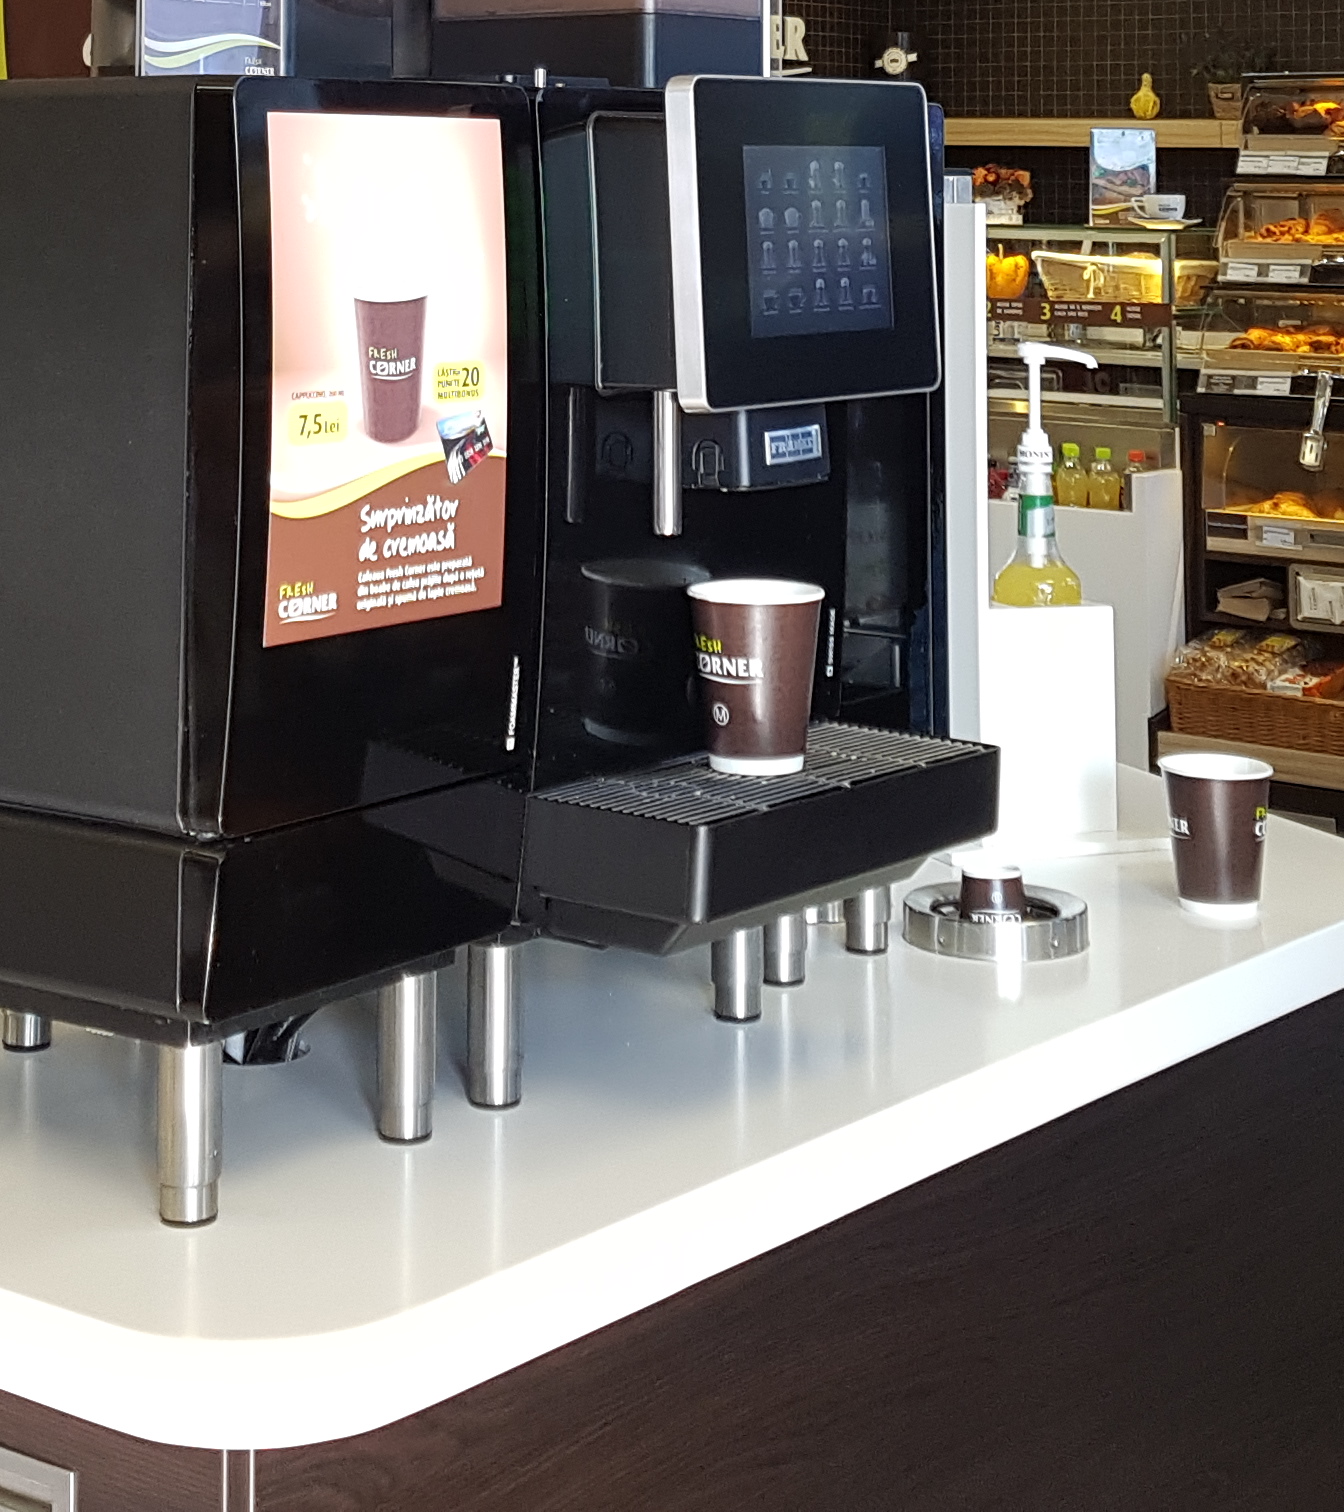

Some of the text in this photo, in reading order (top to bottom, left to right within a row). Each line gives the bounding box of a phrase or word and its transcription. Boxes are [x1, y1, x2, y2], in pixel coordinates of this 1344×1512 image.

[1040, 303, 1051, 320] 3
[1110, 305, 1122, 323] 4
[369, 346, 398, 360] FRESH
[461, 367, 480, 388] 20
[299, 414, 322, 439] 7,5
[360, 495, 459, 533] Surprinzător
[359, 522, 455, 562] de cremoasă
[280, 581, 314, 600] FRESH
